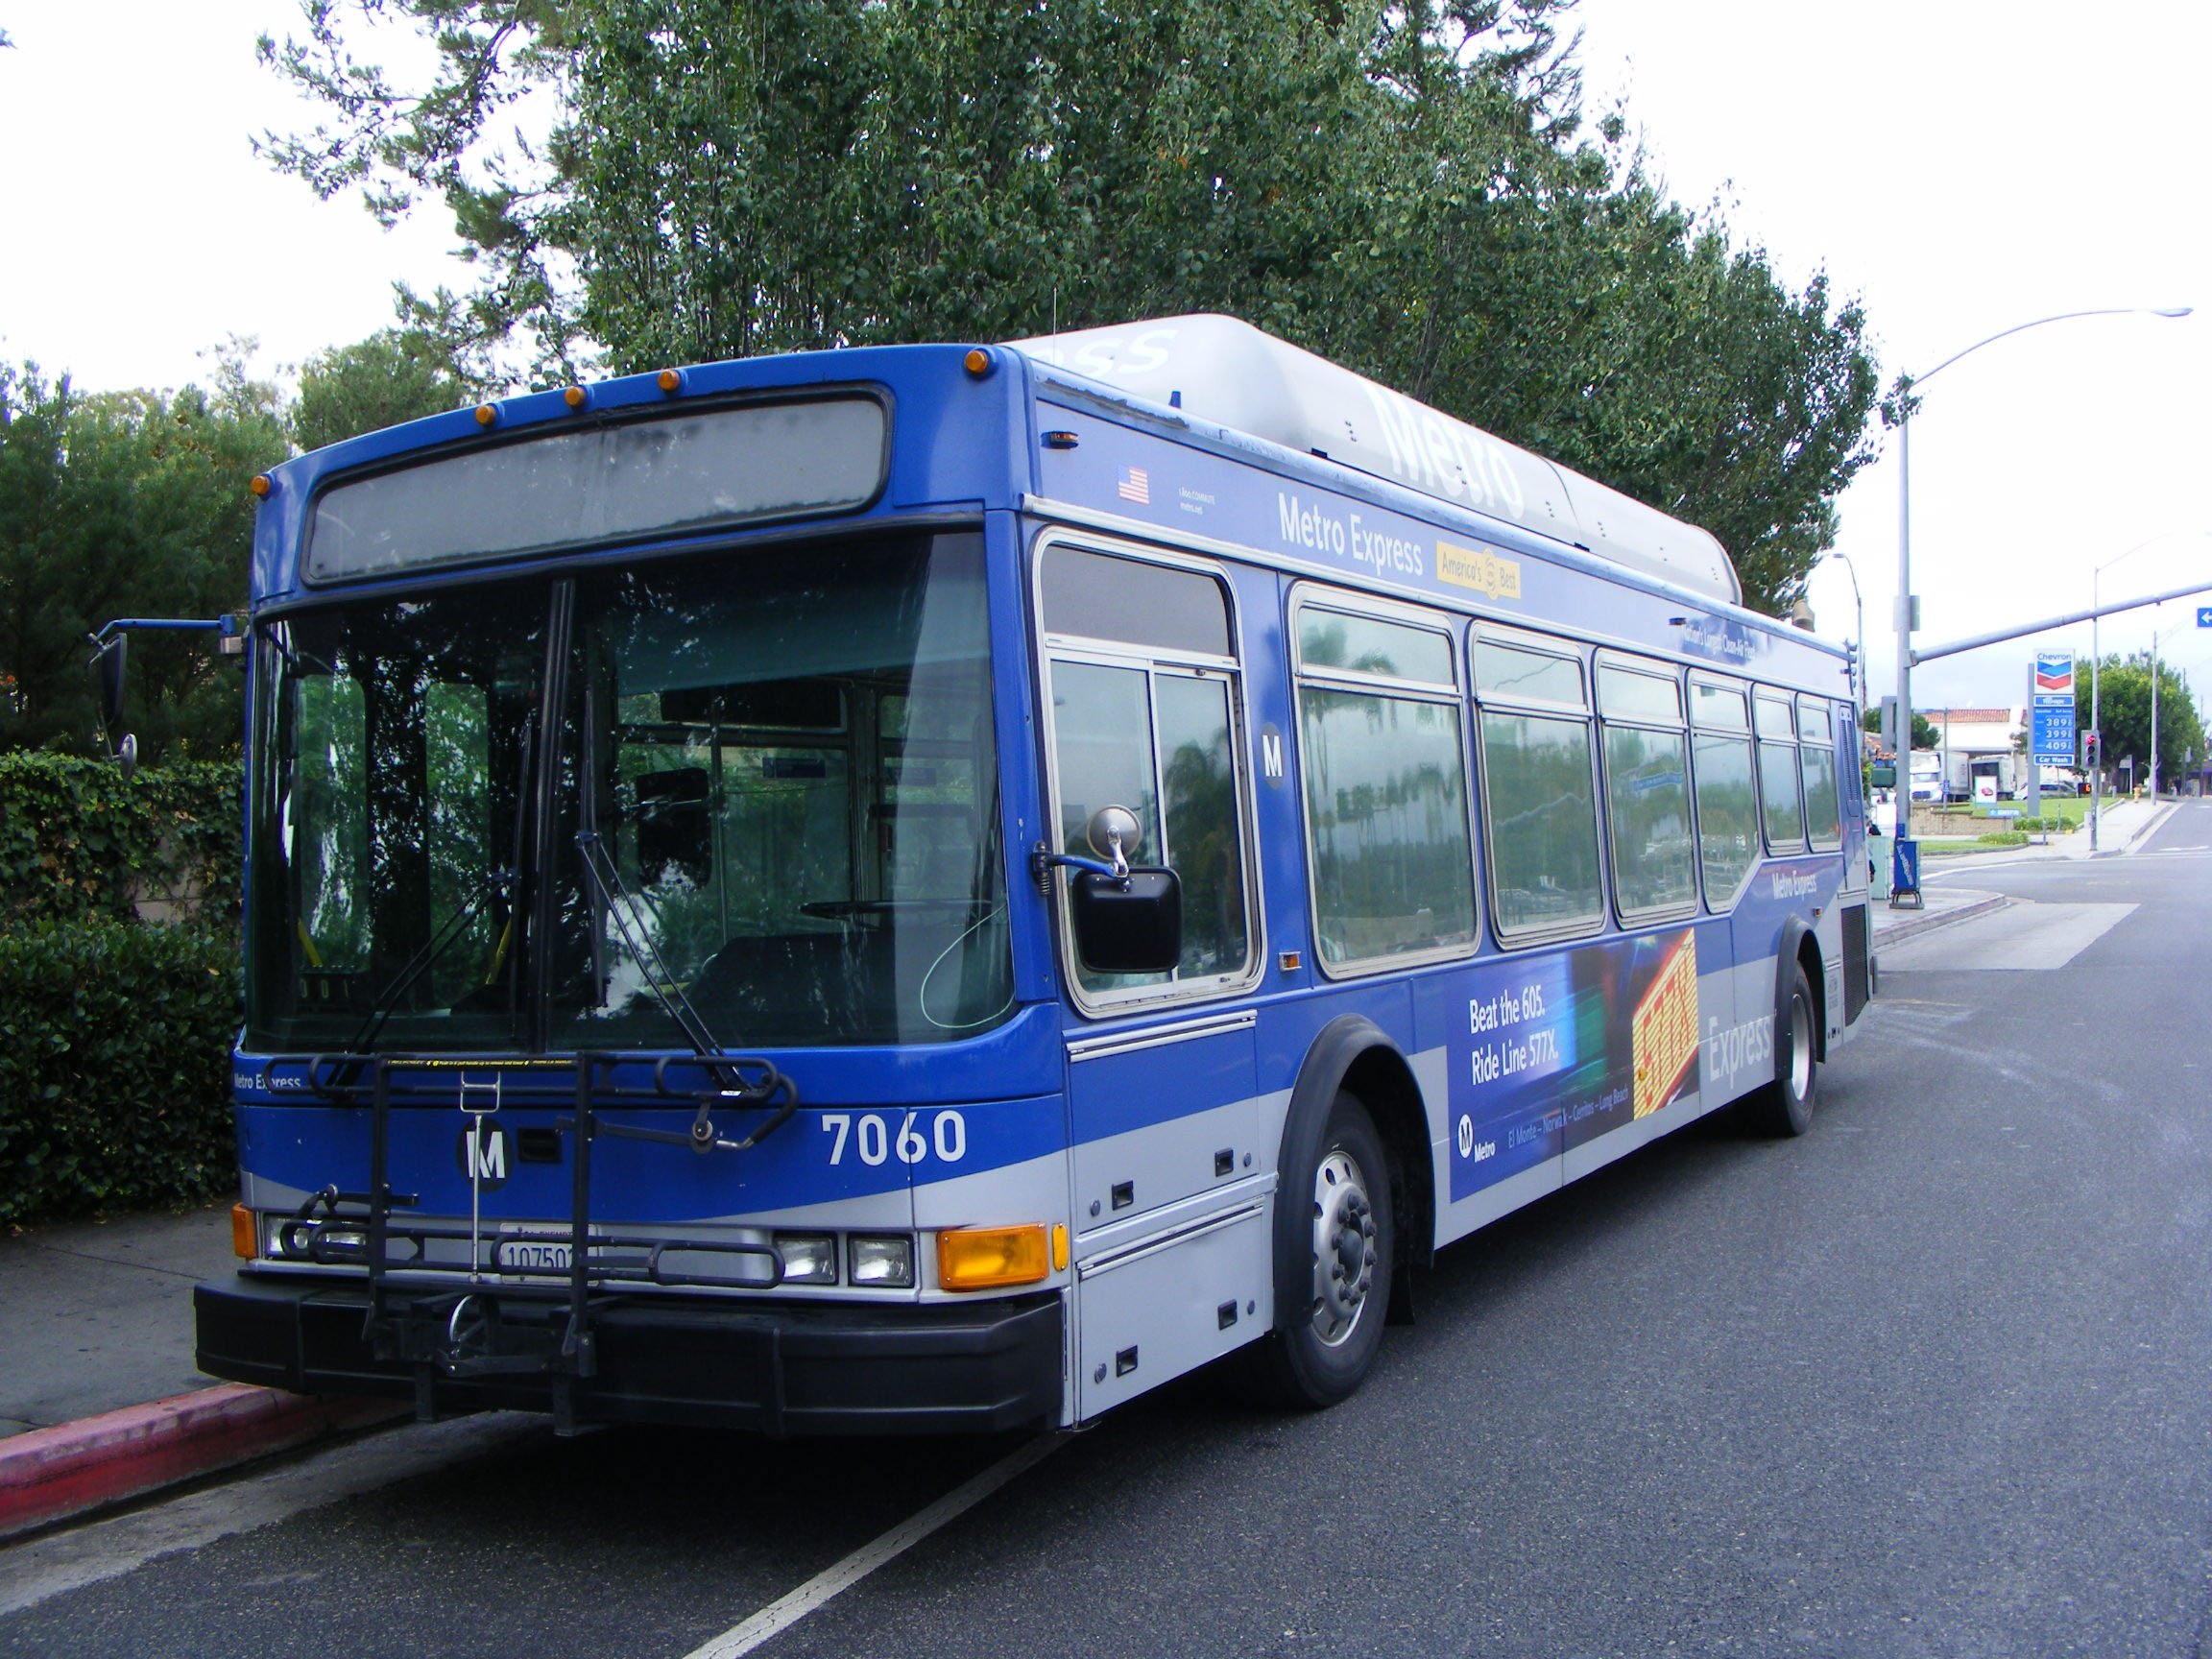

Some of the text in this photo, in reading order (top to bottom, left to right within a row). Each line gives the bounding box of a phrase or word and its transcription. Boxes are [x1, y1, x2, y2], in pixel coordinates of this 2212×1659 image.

[1363, 382, 1525, 519] Metro
[1279, 493, 1345, 555] Metro
[1350, 514, 1423, 576] Express
[1442, 551, 1482, 584] America's
[1499, 566, 1517, 591] Best
[2046, 718, 2067, 727] 389
[2046, 730, 2067, 738] 399
[2046, 741, 2067, 750] 409
[1262, 734, 1283, 777] M
[1772, 870, 1817, 902] Metro Express
[1470, 984, 1545, 1034] Beat the 605.
[1472, 1028, 1559, 1085] Ride Line 577X.
[1709, 1016, 1771, 1089] Express
[822, 1110, 966, 1166] 7060
[1508, 1131, 1515, 1148] El
[1517, 1122, 1537, 1144] Monte
[1599, 1094, 1613, 1112] Long
[1613, 1086, 1629, 1105] Beach
[1474, 1142, 1496, 1163] Metro
